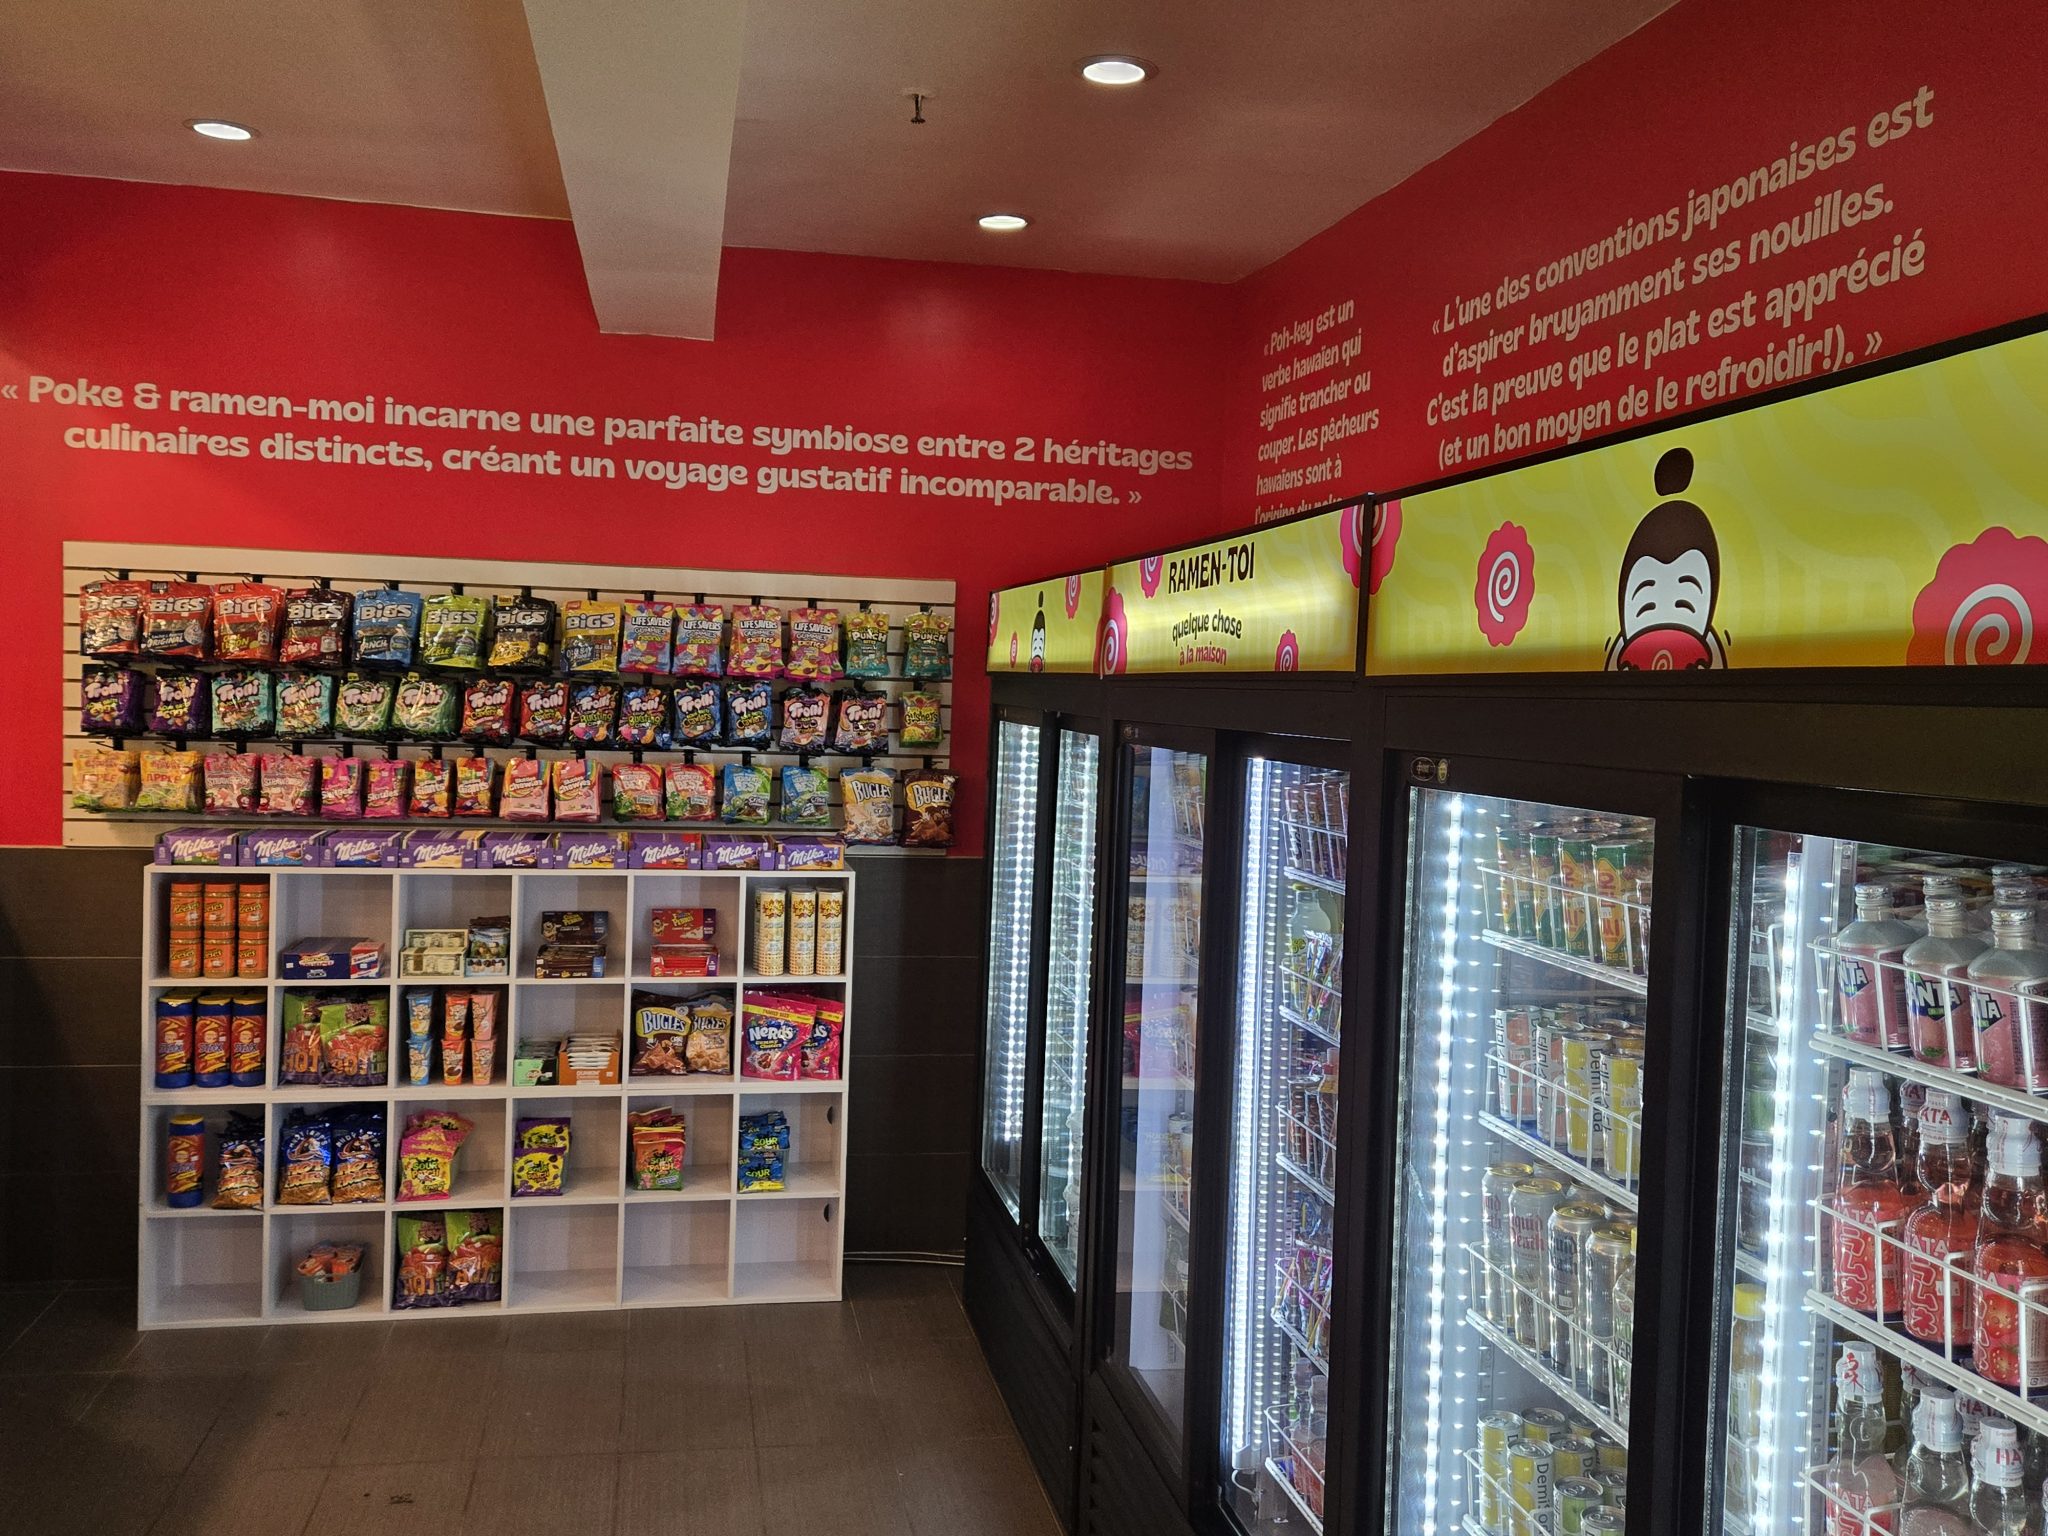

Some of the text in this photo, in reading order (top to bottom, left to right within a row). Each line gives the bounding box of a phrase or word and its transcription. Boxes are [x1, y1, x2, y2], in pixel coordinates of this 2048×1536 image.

[1443, 292, 1491, 332] L'une
[1496, 274, 1530, 310] des
[1535, 207, 1680, 292] conventions
[1681, 126, 1857, 242] japonaises
[1867, 85, 1935, 149] est
[1443, 183, 1894, 377] d'aspirer bruyamment ses nouilles.
[1271, 317, 1314, 355] Poh-key
[1316, 303, 1335, 334] est
[1338, 299, 1355, 324] un
[1427, 228, 1926, 427] C'est la preuve que le plat est apprécié
[1262, 327, 1362, 392] verbe hawaïen qui
[1260, 371, 1371, 432] signifie trancher ou
[1439, 434, 1463, 471] (et
[1466, 432, 1490, 460] un
[1494, 419, 1530, 453] bon
[1536, 400, 1611, 445] moyen
[1618, 384, 1648, 422] de
[1655, 376, 1678, 413] le
[1685, 324, 1855, 406] refroidir!).
[28, 375, 123, 408] Poke
[133, 383, 161, 410] &
[170, 388, 375, 424] ramen-moi
[385, 396, 521, 433] incarne
[530, 412, 595, 437] une
[604, 415, 744, 446] parfaite
[752, 425, 909, 456] symbiose
[917, 433, 1005, 461] entre
[1014, 436, 1035, 462] 2
[1044, 438, 1193, 475] héritages
[1258, 408, 1380, 464] couper. Les pêcheurs
[64, 423, 250, 458] culinaires
[260, 432, 433, 472] distincts,
[442, 444, 562, 476] créant
[570, 456, 615, 479] un
[625, 459, 748, 493] voyage
[757, 466, 892, 495] gustatif
[900, 467, 1120, 507] incomparable.
[1305, 458, 1332, 485] sont
[1334, 453, 1342, 479] à
[1168, 541, 1255, 594] RAMEN-TOI
[1172, 608, 1242, 646] quelque chose
[1186, 645, 1195, 662] la
[1196, 641, 1227, 666] maison
[171, 838, 215, 857] Milka
[254, 838, 298, 857] Milka
[334, 838, 380, 859] Milka
[414, 842, 457, 861] Milka
[492, 841, 531, 860] Milka
[568, 843, 607, 862] Milka
[641, 844, 681, 863] Milka
[715, 843, 753, 863] Milka
[788, 847, 826, 866] Milka
[641, 1010, 685, 1034] BUGLES
[754, 1137, 778, 1146] SOUR
[746, 1168, 770, 1178] SOUR
